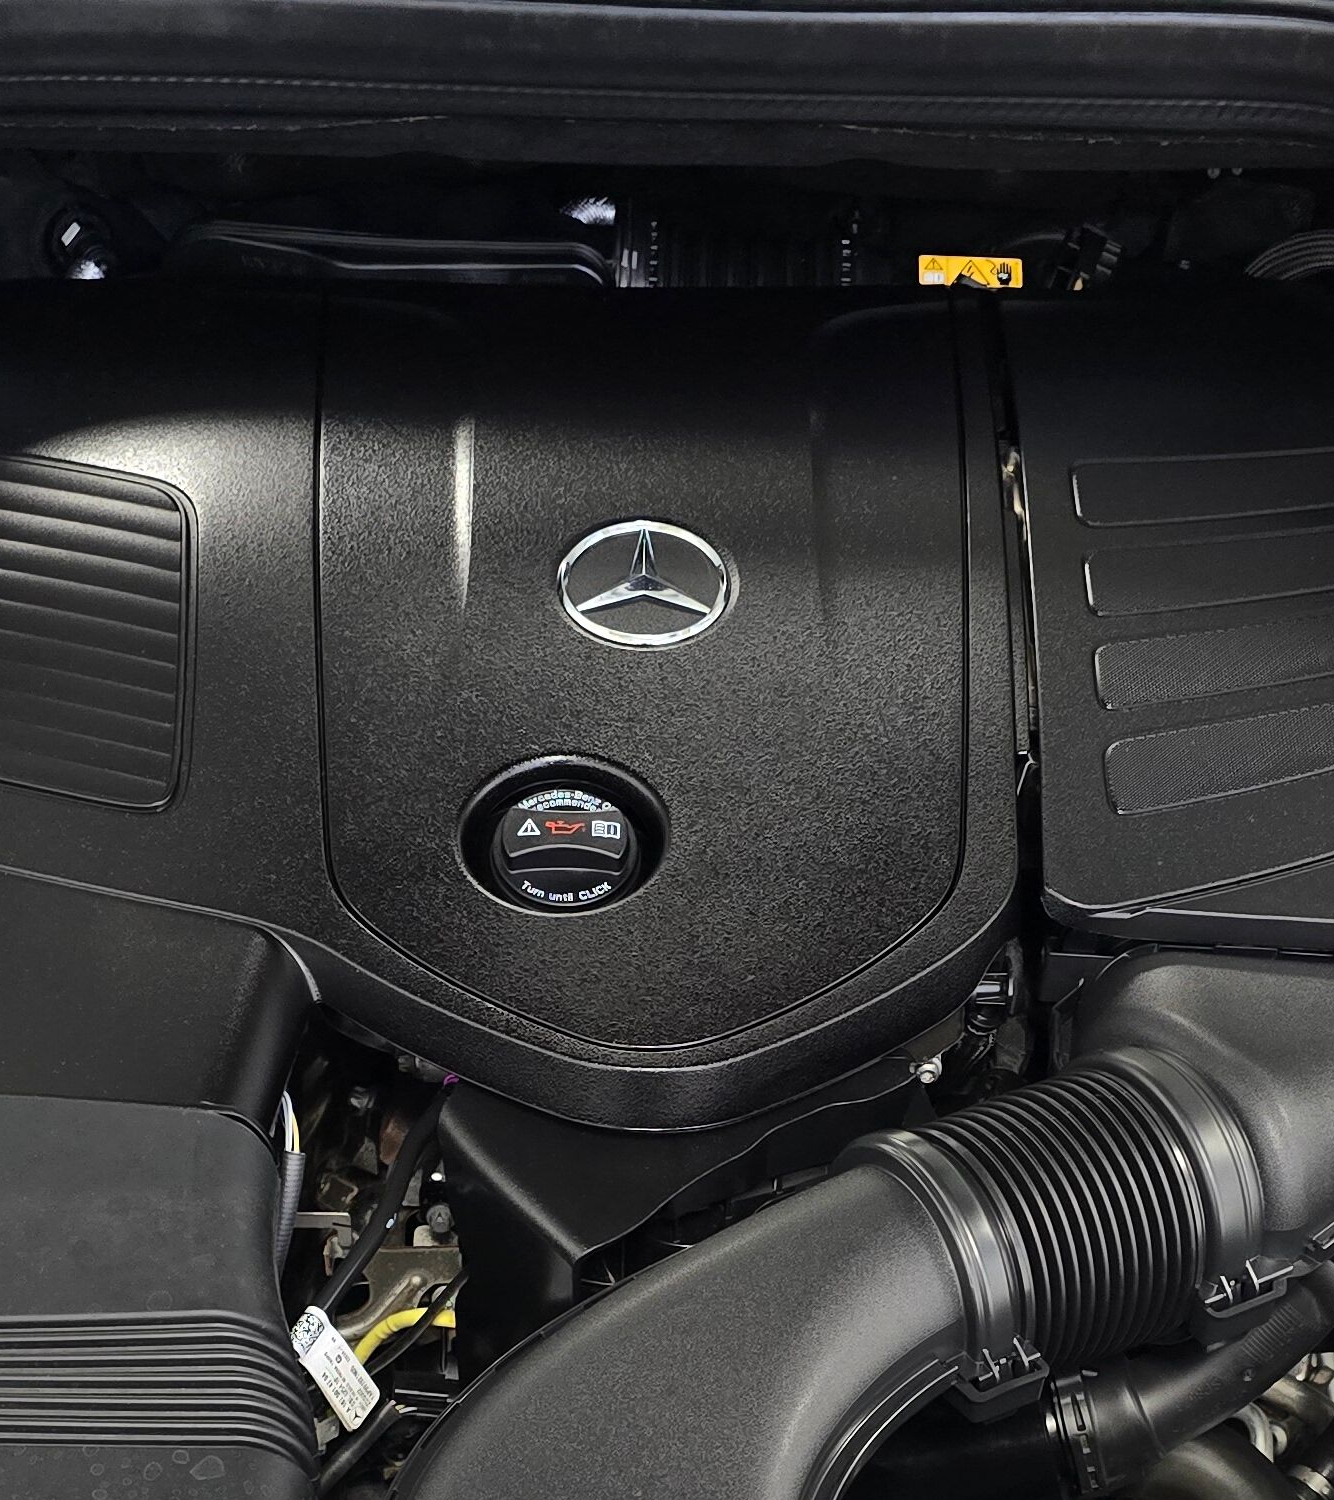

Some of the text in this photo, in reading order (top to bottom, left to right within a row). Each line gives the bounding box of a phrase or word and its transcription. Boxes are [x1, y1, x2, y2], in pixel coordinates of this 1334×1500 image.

[517, 789, 602, 811] Mercedes-Benz
[521, 880, 612, 902] Turn until CLICK
